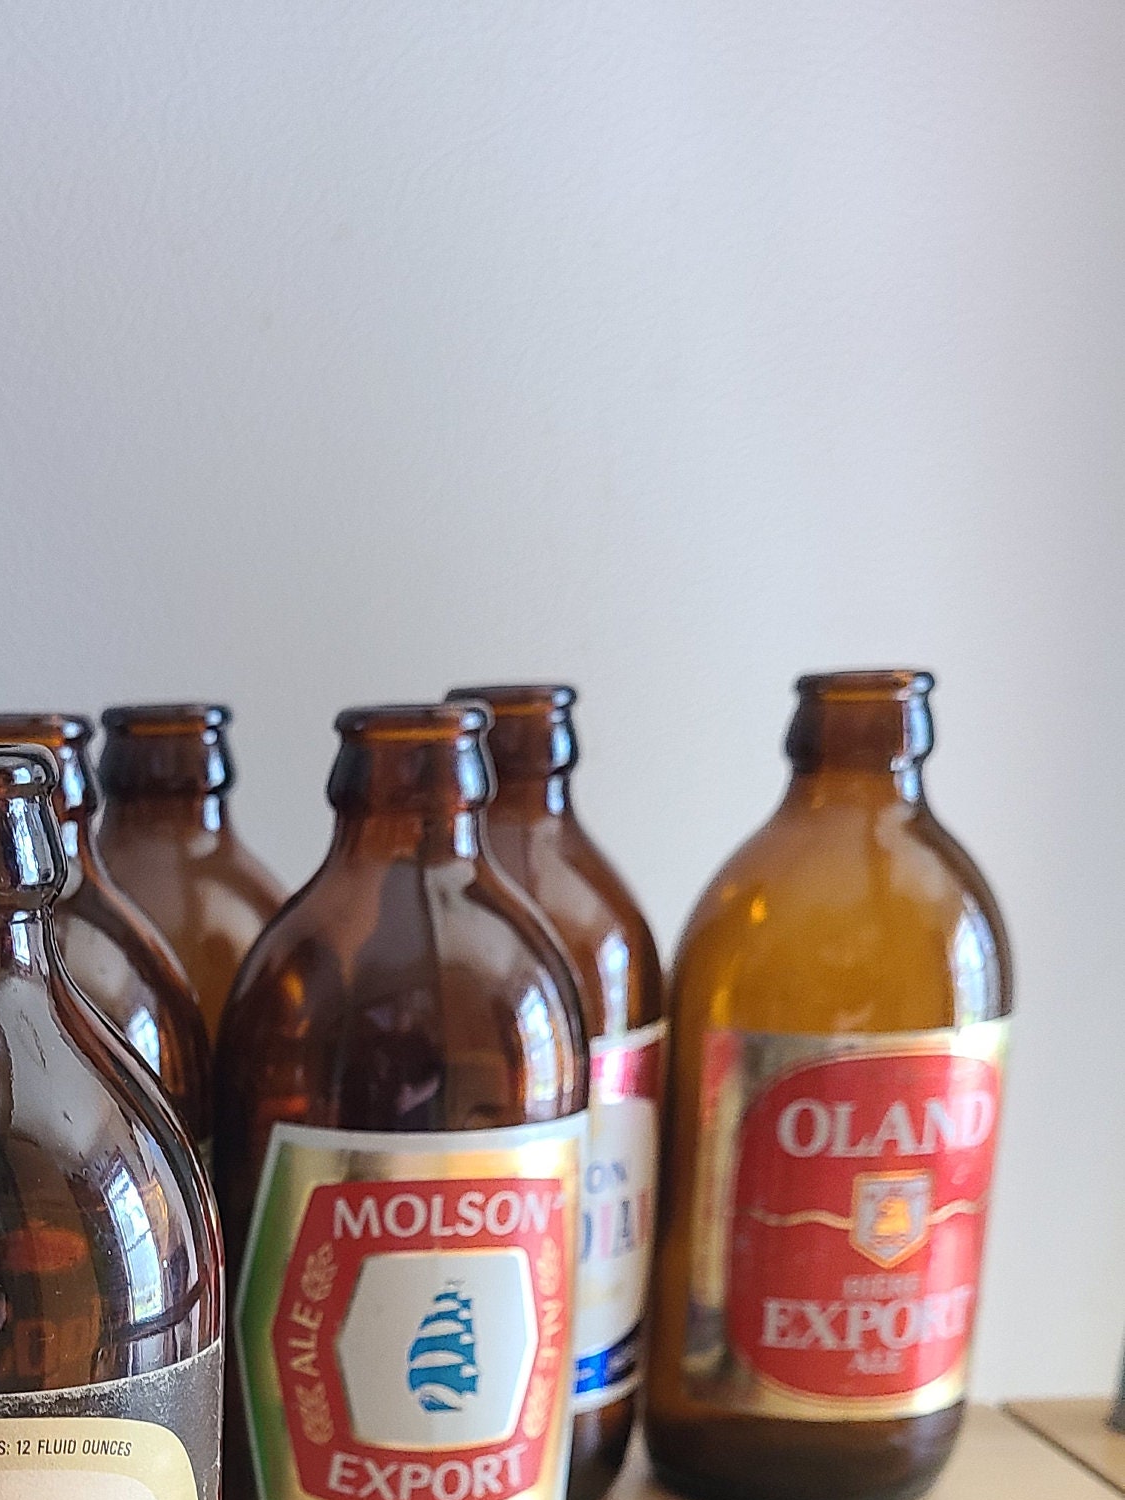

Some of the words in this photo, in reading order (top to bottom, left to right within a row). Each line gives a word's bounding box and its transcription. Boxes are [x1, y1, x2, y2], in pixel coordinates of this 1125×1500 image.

[776, 1089, 994, 1159] OLAND
[287, 1302, 323, 1377] ALE
[761, 1284, 973, 1351] EXPORT
[16, 1440, 31, 1456] 12
[37, 1439, 76, 1455] FLUID
[82, 1439, 132, 1457] OUNCES
